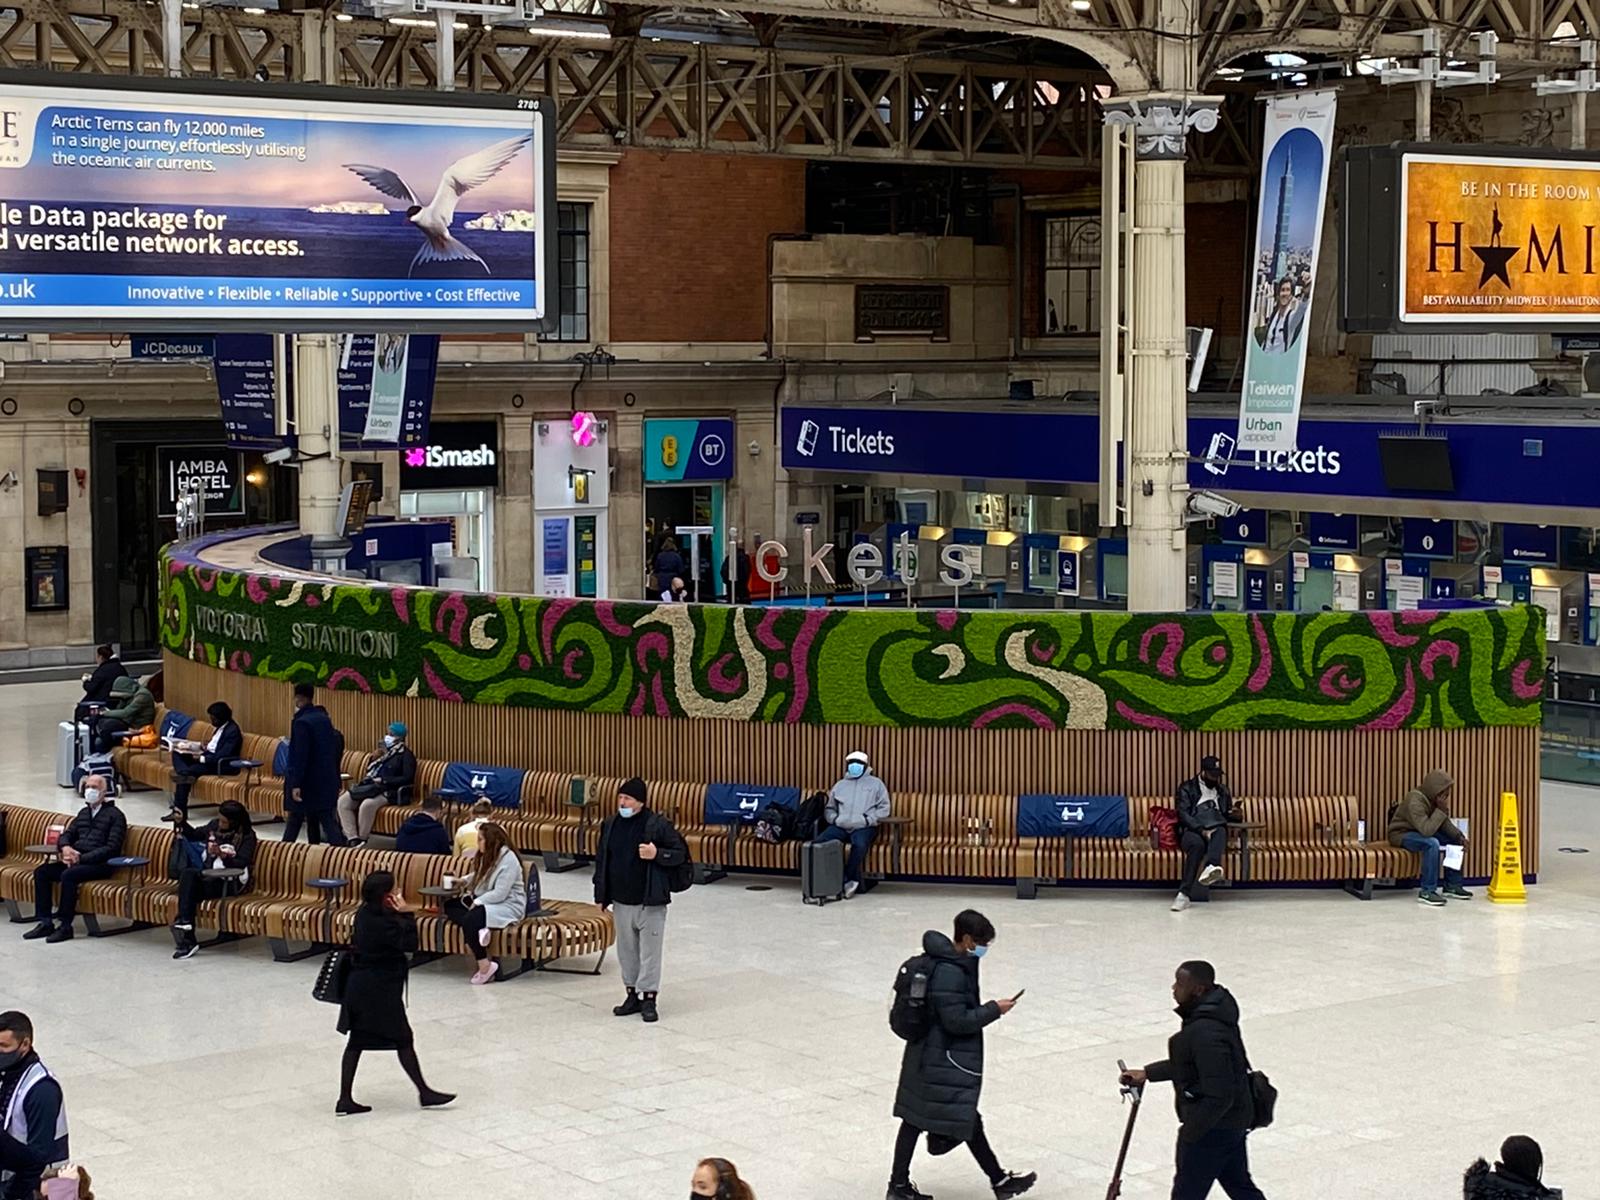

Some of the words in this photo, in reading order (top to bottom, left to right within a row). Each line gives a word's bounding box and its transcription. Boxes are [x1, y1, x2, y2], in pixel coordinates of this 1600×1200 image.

[51, 114, 92, 129] Arctic
[95, 116, 134, 131] Terns
[136, 120, 161, 132] can
[164, 119, 181, 136] fly
[184, 121, 227, 137] 12,000
[230, 124, 265, 137] miles
[52, 132, 65, 146] in
[68, 136, 78, 147] a
[80, 134, 121, 152] single
[255, 142, 306, 160] utilising
[52, 151, 76, 165] the
[79, 154, 132, 167] oceanic
[134, 155, 154, 168] air
[156, 157, 216, 171] currents.
[1461, 181, 1478, 196] BE
[1484, 182, 1501, 197] IN
[1507, 182, 1538, 198] THE
[1544, 184, 1590, 199] ROOM
[29, 204, 86, 226] Data
[92, 206, 188, 235] package
[193, 209, 227, 230] for
[14, 230, 119, 252] versatile
[126, 233, 223, 254] network
[227, 238, 305, 256] access.
[128, 285, 204, 299] Innovative
[218, 286, 272, 300] Flexible
[284, 286, 339, 301] Reliable
[351, 287, 423, 304] Supportive
[434, 288, 464, 301] Cost
[466, 288, 521, 302] Effective
[1423, 295, 1443, 305] BEST
[1444, 295, 1504, 306] AVAILABILITY
[1505, 295, 1547, 306] MIDWEEK
[141, 342, 204, 354] JCDecaux
[1248, 380, 1294, 396] Taiwan
[1245, 417, 1282, 431] Urban
[829, 426, 895, 455] Tickets
[1244, 432, 1276, 443] appeal
[426, 443, 495, 467] iSmash
[705, 444, 720, 456] BT
[177, 460, 228, 474] AMBA
[178, 475, 231, 490] HOTEL
[675, 524, 974, 586] Tickets
[196, 605, 268, 643] VICTORIA
[291, 622, 399, 659] STATION
